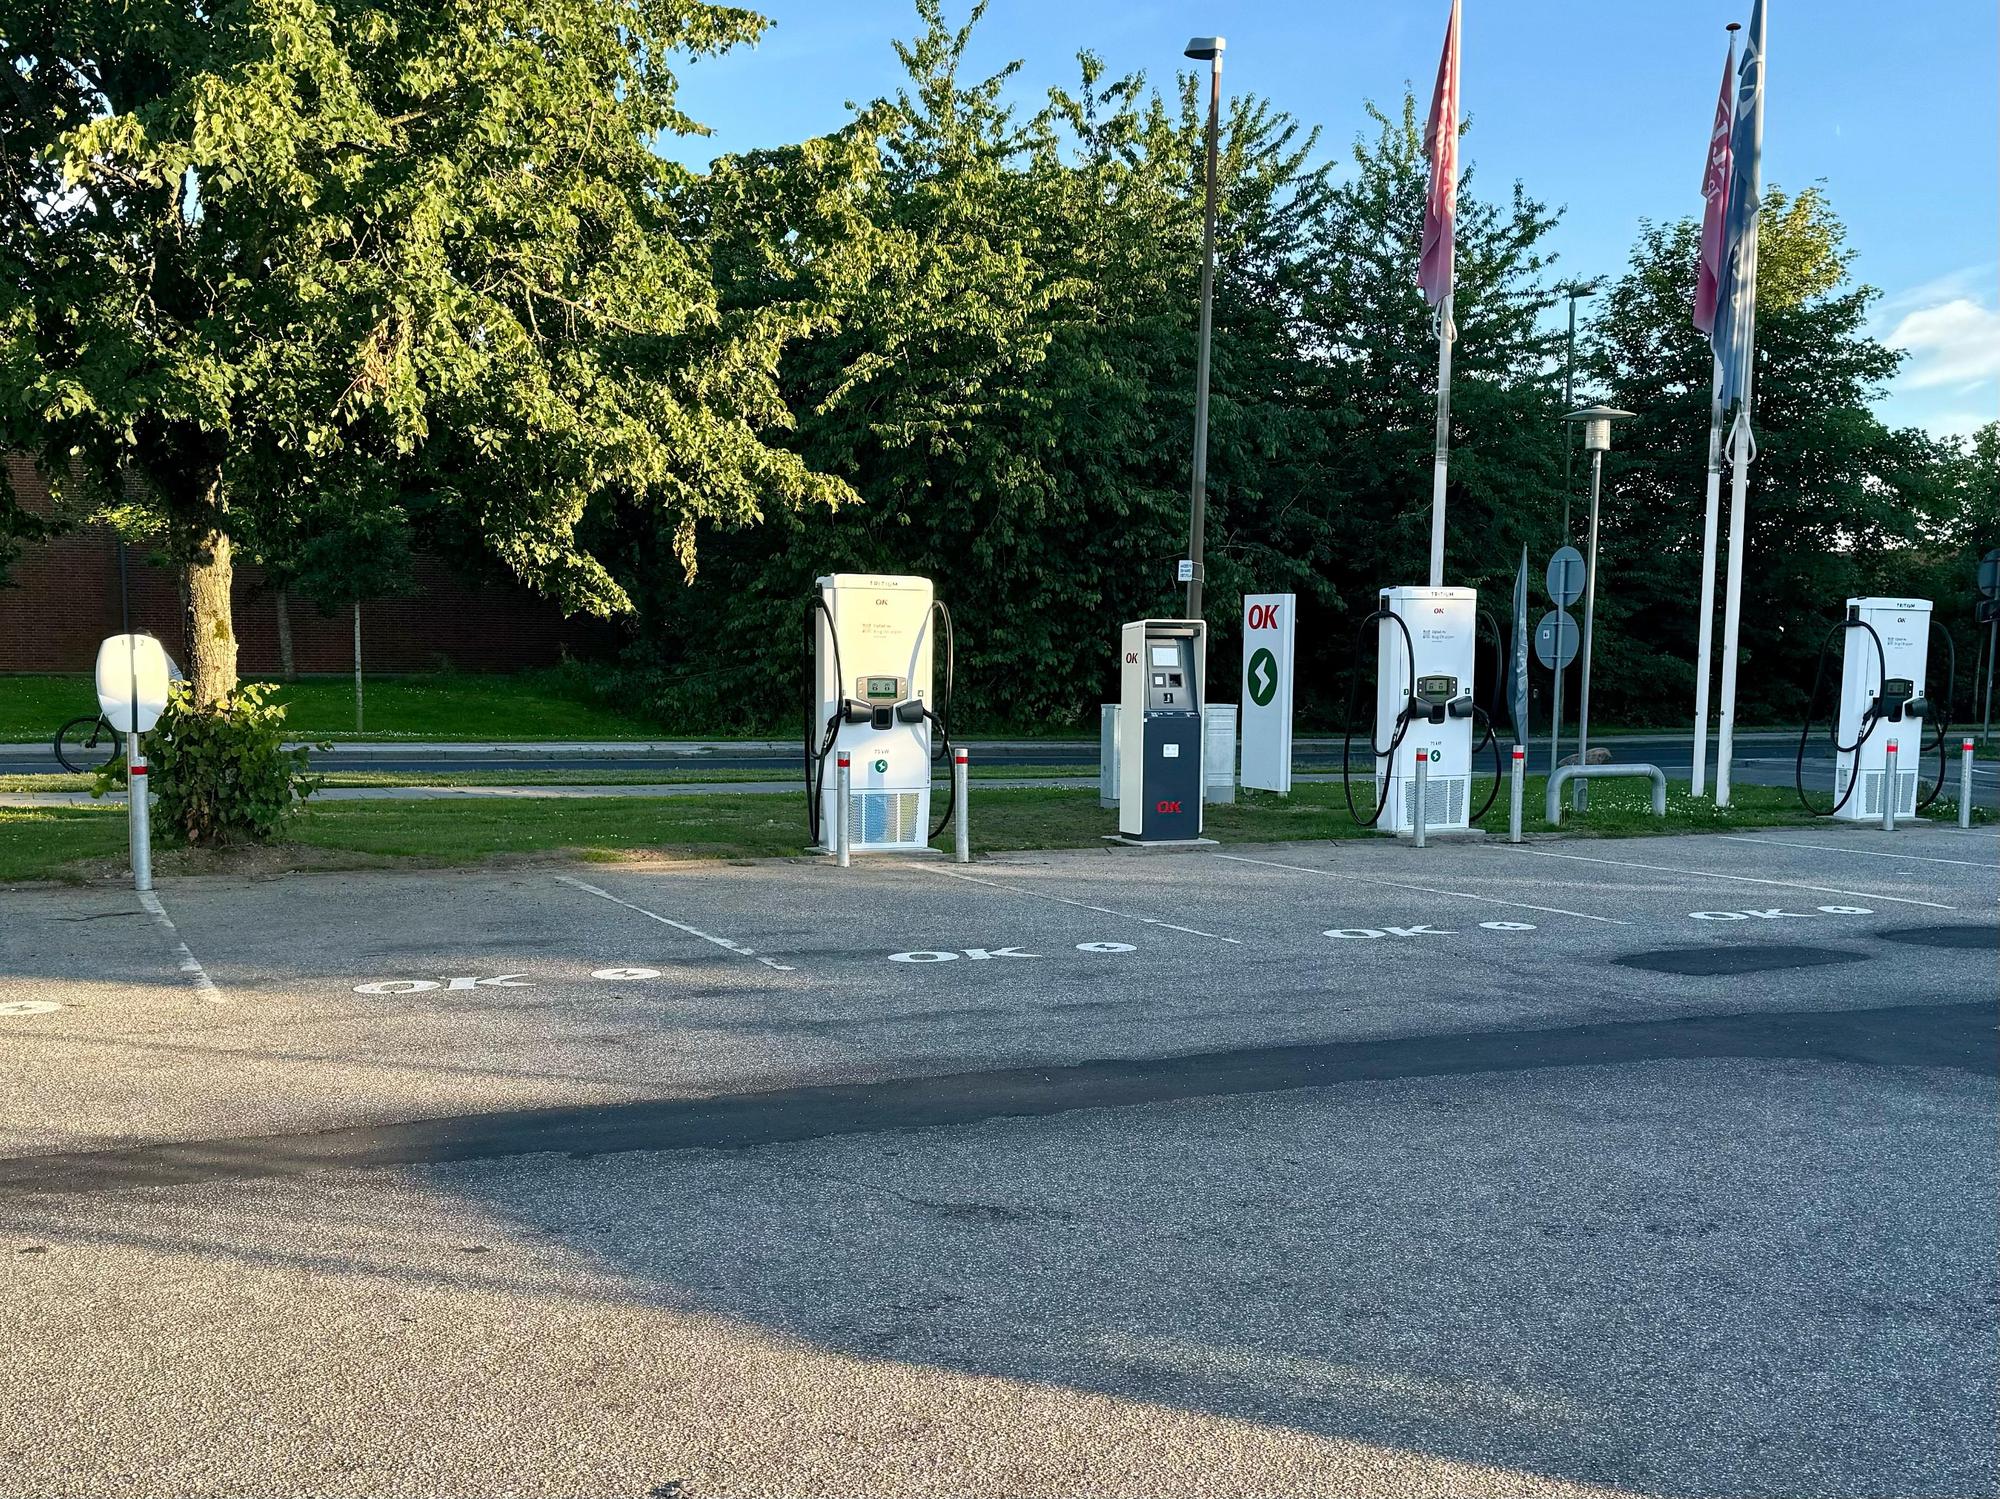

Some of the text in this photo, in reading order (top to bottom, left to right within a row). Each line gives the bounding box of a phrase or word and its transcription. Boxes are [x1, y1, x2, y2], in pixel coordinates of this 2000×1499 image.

[875, 598, 888, 606] OK
[1248, 604, 1280, 630] OK
[1125, 652, 1138, 664] OK
[1156, 800, 1182, 813] OK
[1688, 909, 1817, 920] OK
[1322, 925, 1459, 938] OK
[887, 947, 1042, 962] OK
[353, 973, 537, 994] OK
